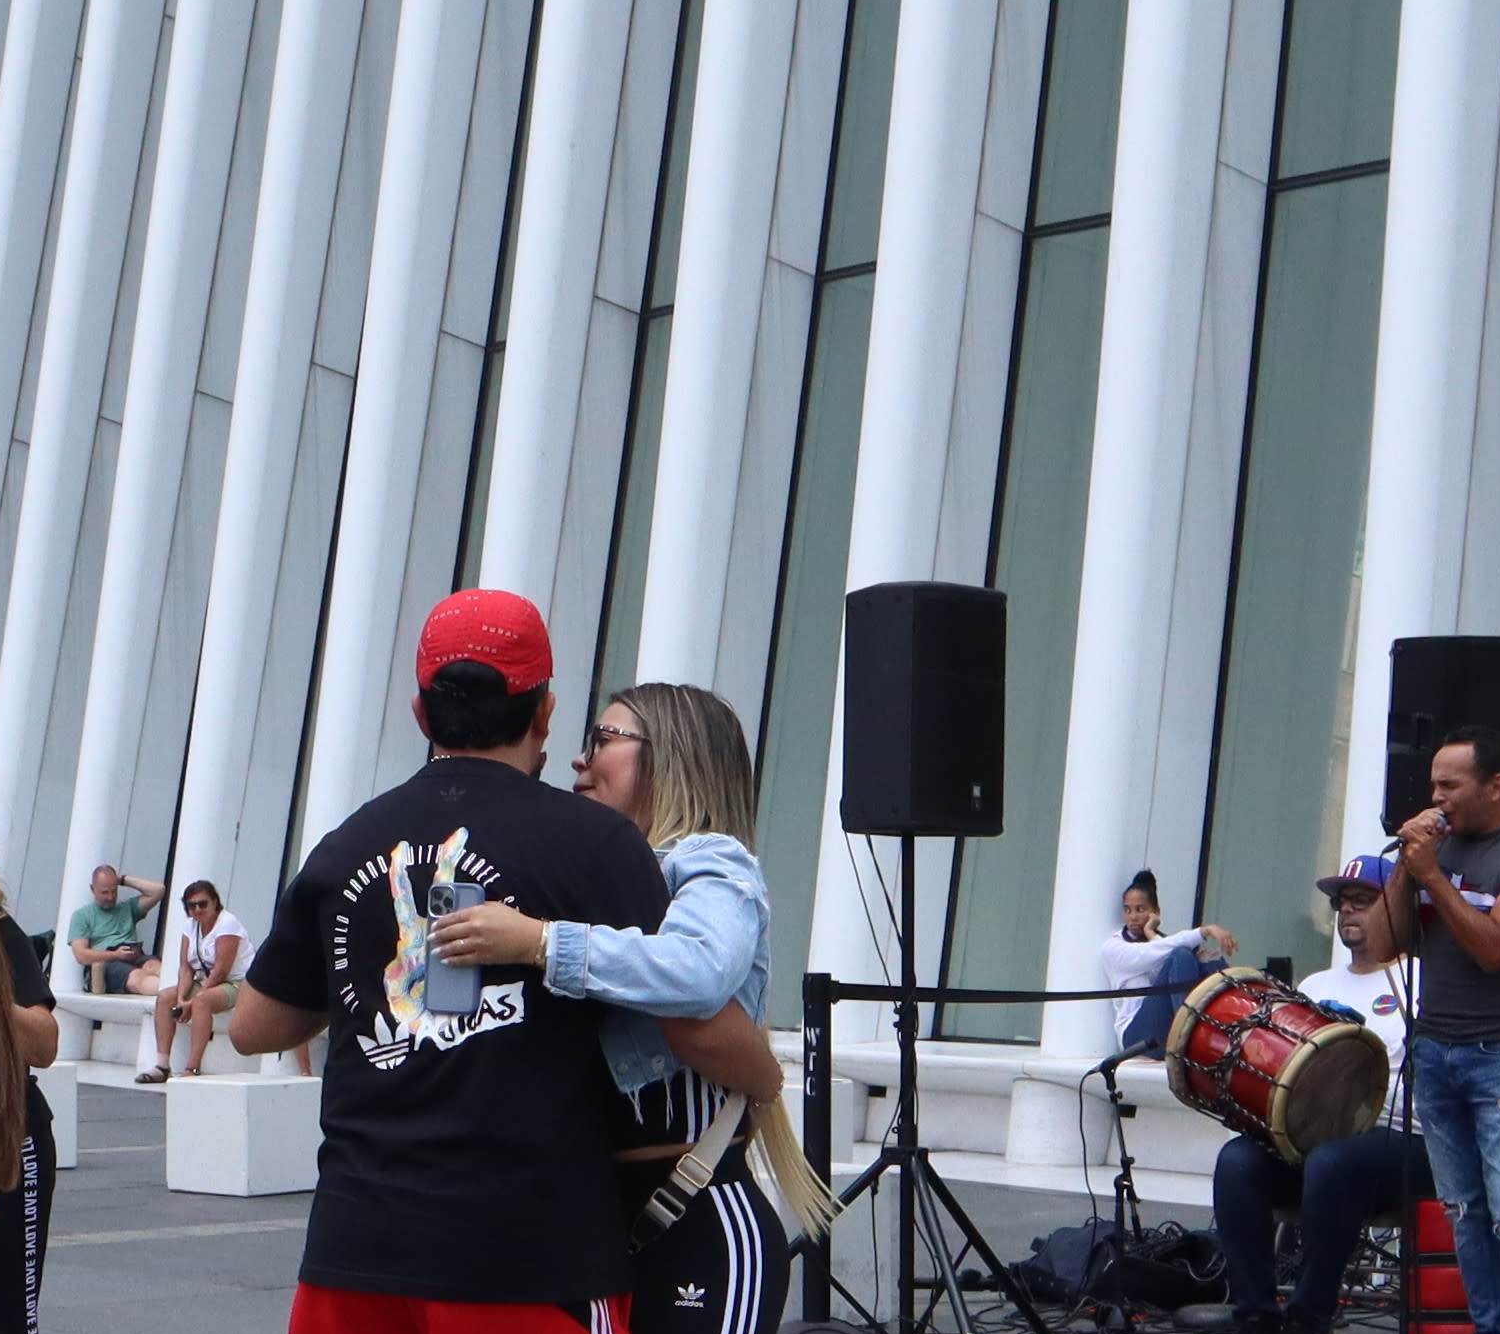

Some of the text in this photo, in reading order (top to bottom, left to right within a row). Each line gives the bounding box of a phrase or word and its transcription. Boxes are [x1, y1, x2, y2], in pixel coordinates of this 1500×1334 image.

[333, 914, 350, 971] WORLD
[343, 854, 389, 904] BRAND
[22, 1154, 39, 1188] LOVE
[24, 1190, 38, 1223] LOVE
[25, 1224, 37, 1258] LOVE
[25, 1259, 37, 1292] LOVE
[26, 1292, 38, 1326] LOVE
[674, 1299, 705, 1308] adidas
